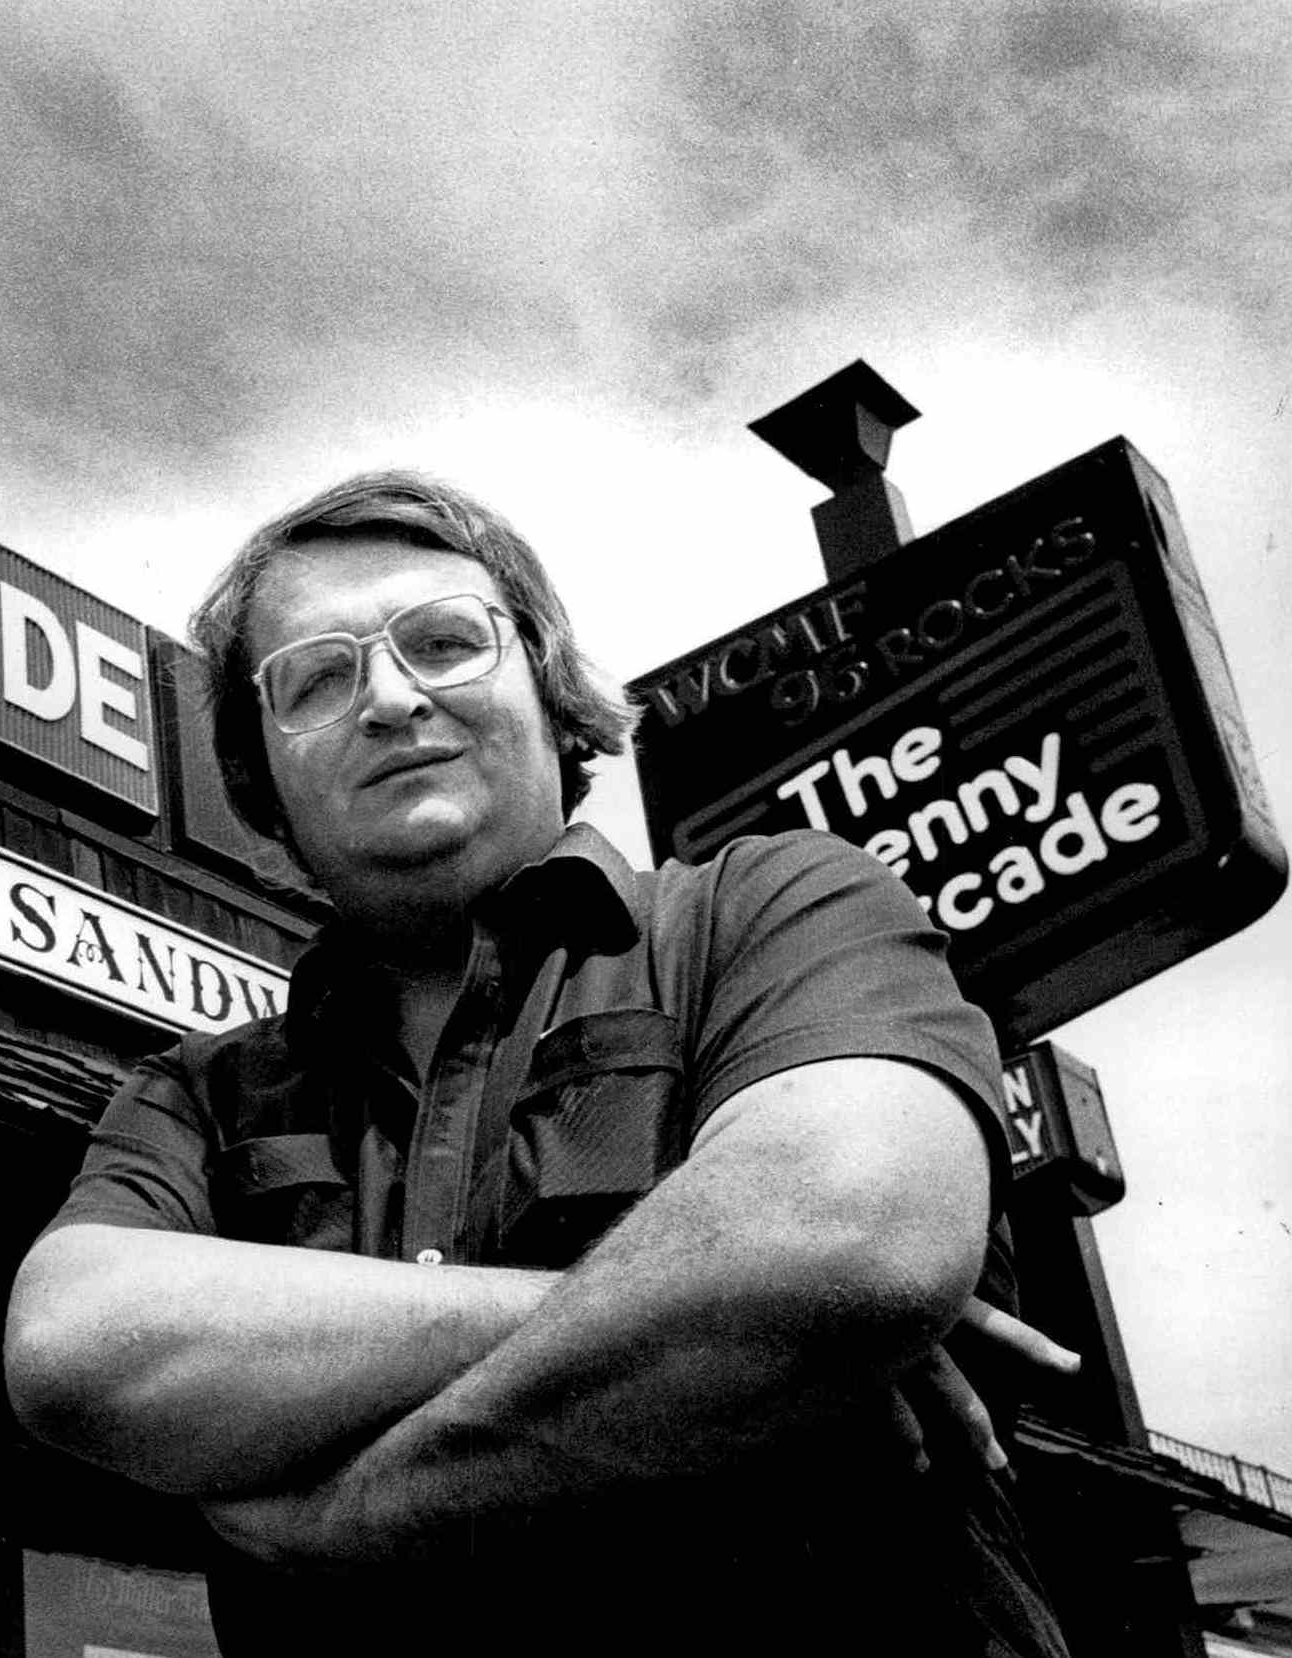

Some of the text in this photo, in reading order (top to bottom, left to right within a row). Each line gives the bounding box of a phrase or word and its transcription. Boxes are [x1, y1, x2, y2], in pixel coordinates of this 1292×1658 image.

[874, 516, 1095, 678] ROCKS
[777, 726, 942, 832] The
[863, 732, 1061, 880] enny
[917, 783, 1161, 930] cade
